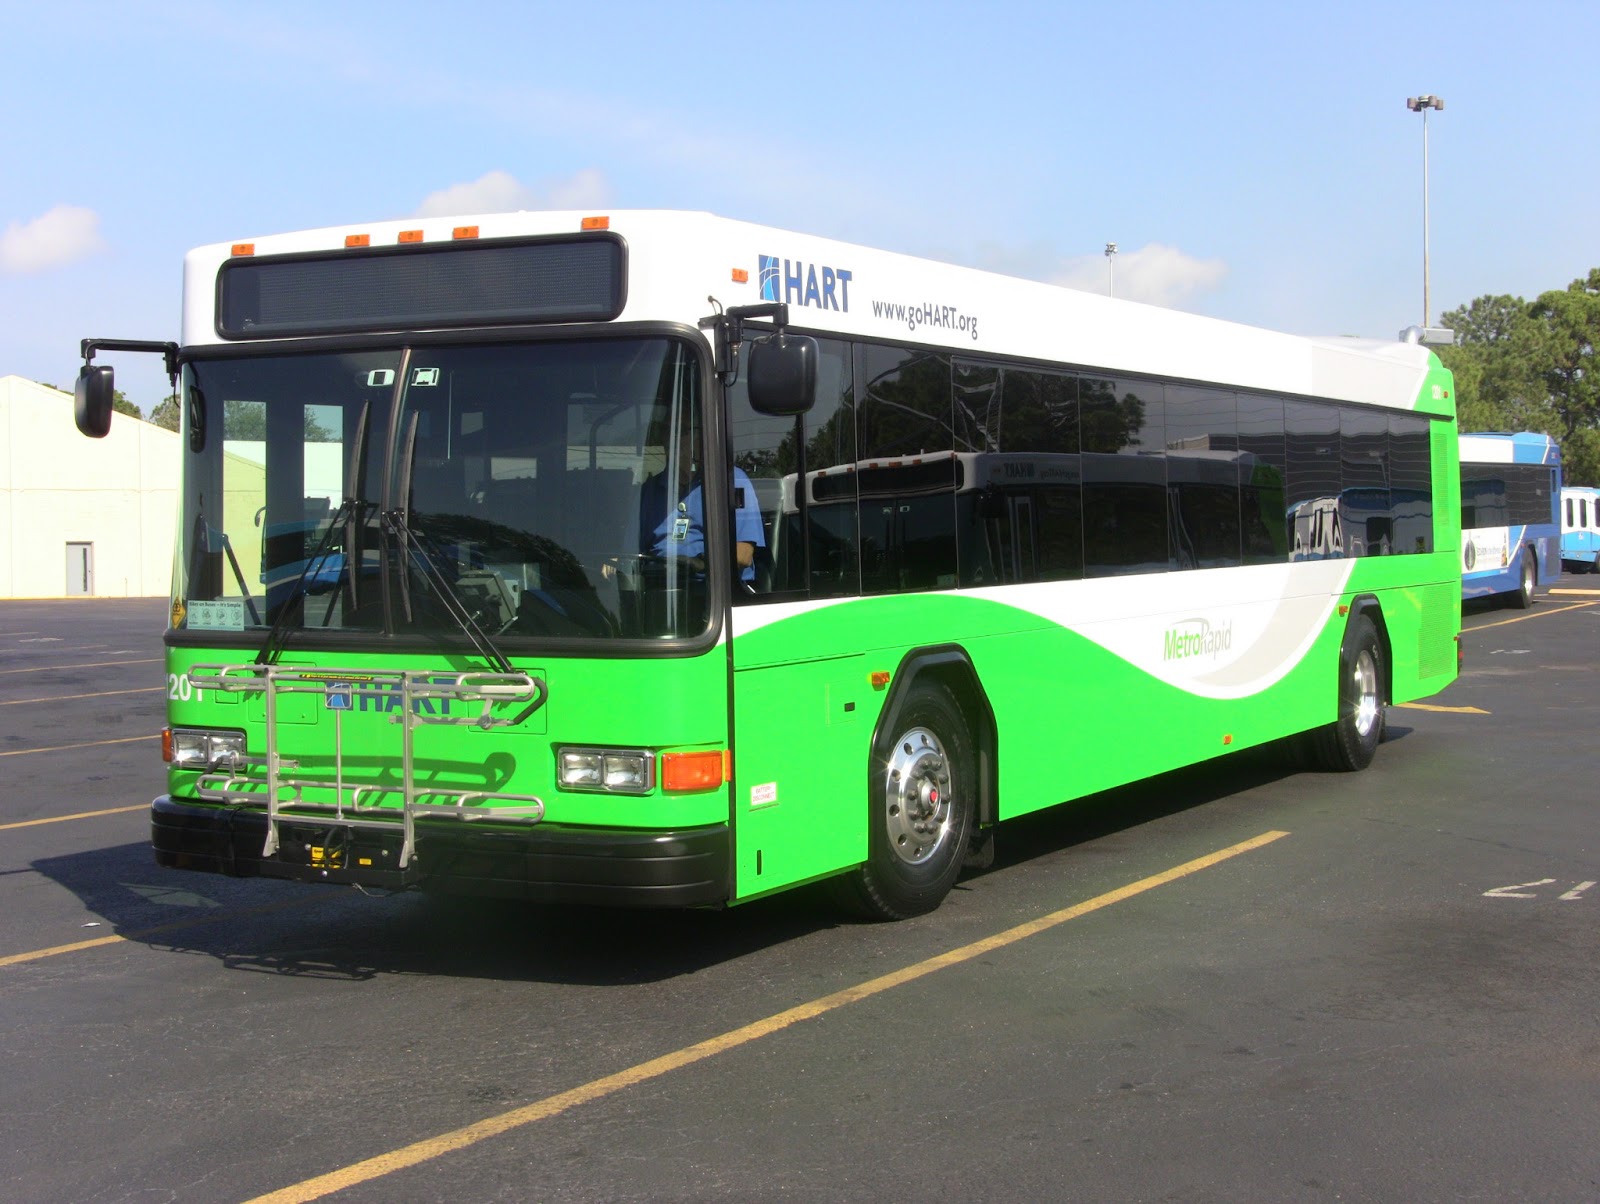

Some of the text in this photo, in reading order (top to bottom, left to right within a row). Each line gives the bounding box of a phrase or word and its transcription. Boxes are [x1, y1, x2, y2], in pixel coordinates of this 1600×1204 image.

[784, 258, 852, 313] HART
[872, 299, 978, 340] www.goHART.org
[1164, 617, 1232, 661] MetroRapid
[166, 672, 203, 702] 201
